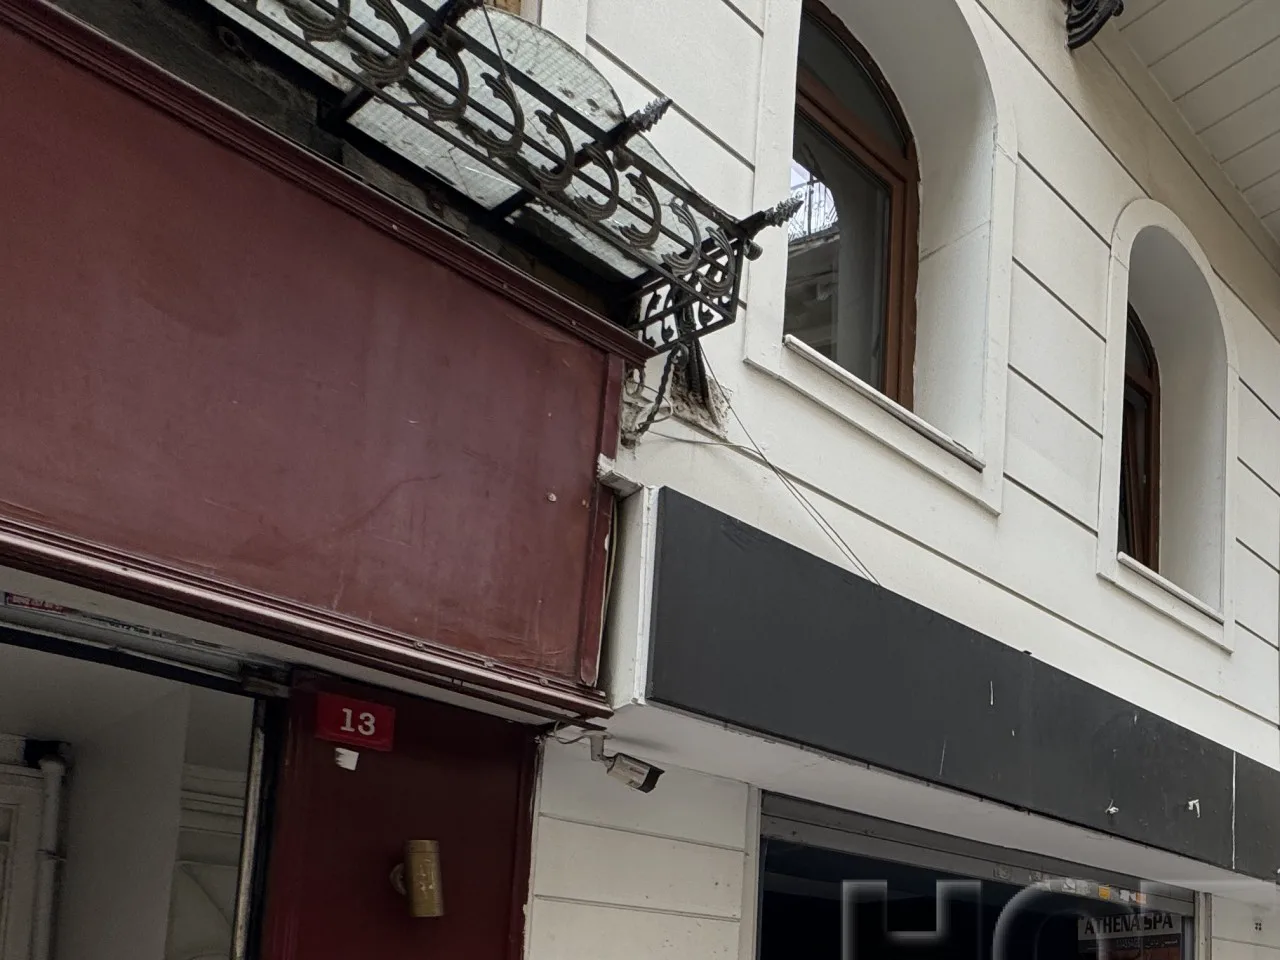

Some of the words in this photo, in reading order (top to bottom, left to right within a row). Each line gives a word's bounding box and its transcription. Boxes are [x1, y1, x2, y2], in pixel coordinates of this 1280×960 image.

[340, 708, 376, 736] 13
[1084, 914, 1141, 935] ATHENA
[1143, 911, 1174, 931] SPA
